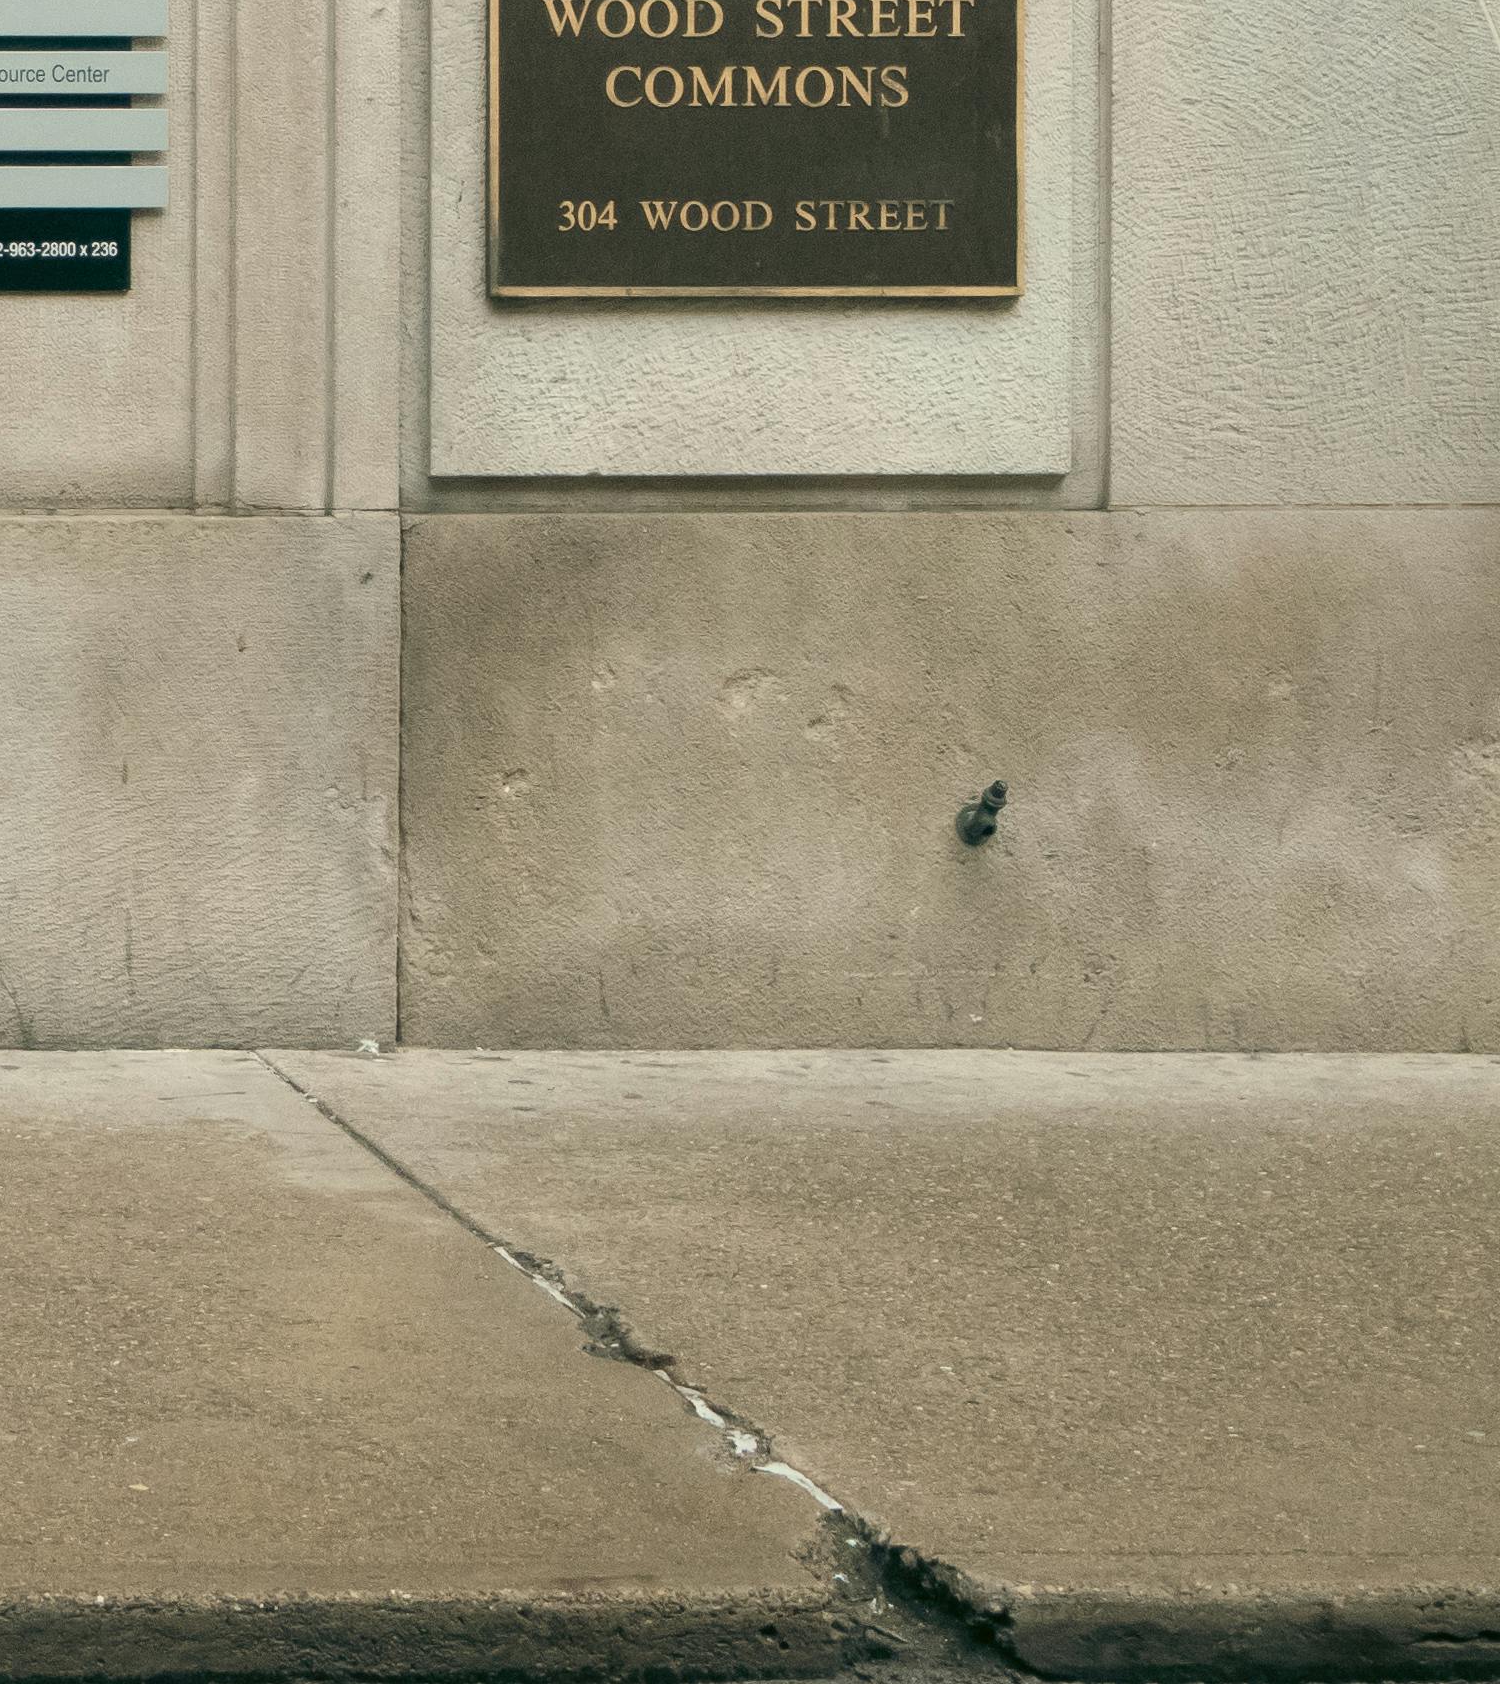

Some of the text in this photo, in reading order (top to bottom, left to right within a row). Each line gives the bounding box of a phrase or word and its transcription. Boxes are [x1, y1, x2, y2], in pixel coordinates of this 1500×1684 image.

[51, 65, 110, 83] Center
[605, 65, 910, 109] COMMONS
[557, 199, 955, 232] 304 WOOD STREET
[79, 246, 88, 257] x
[91, 242, 118, 257] 236
